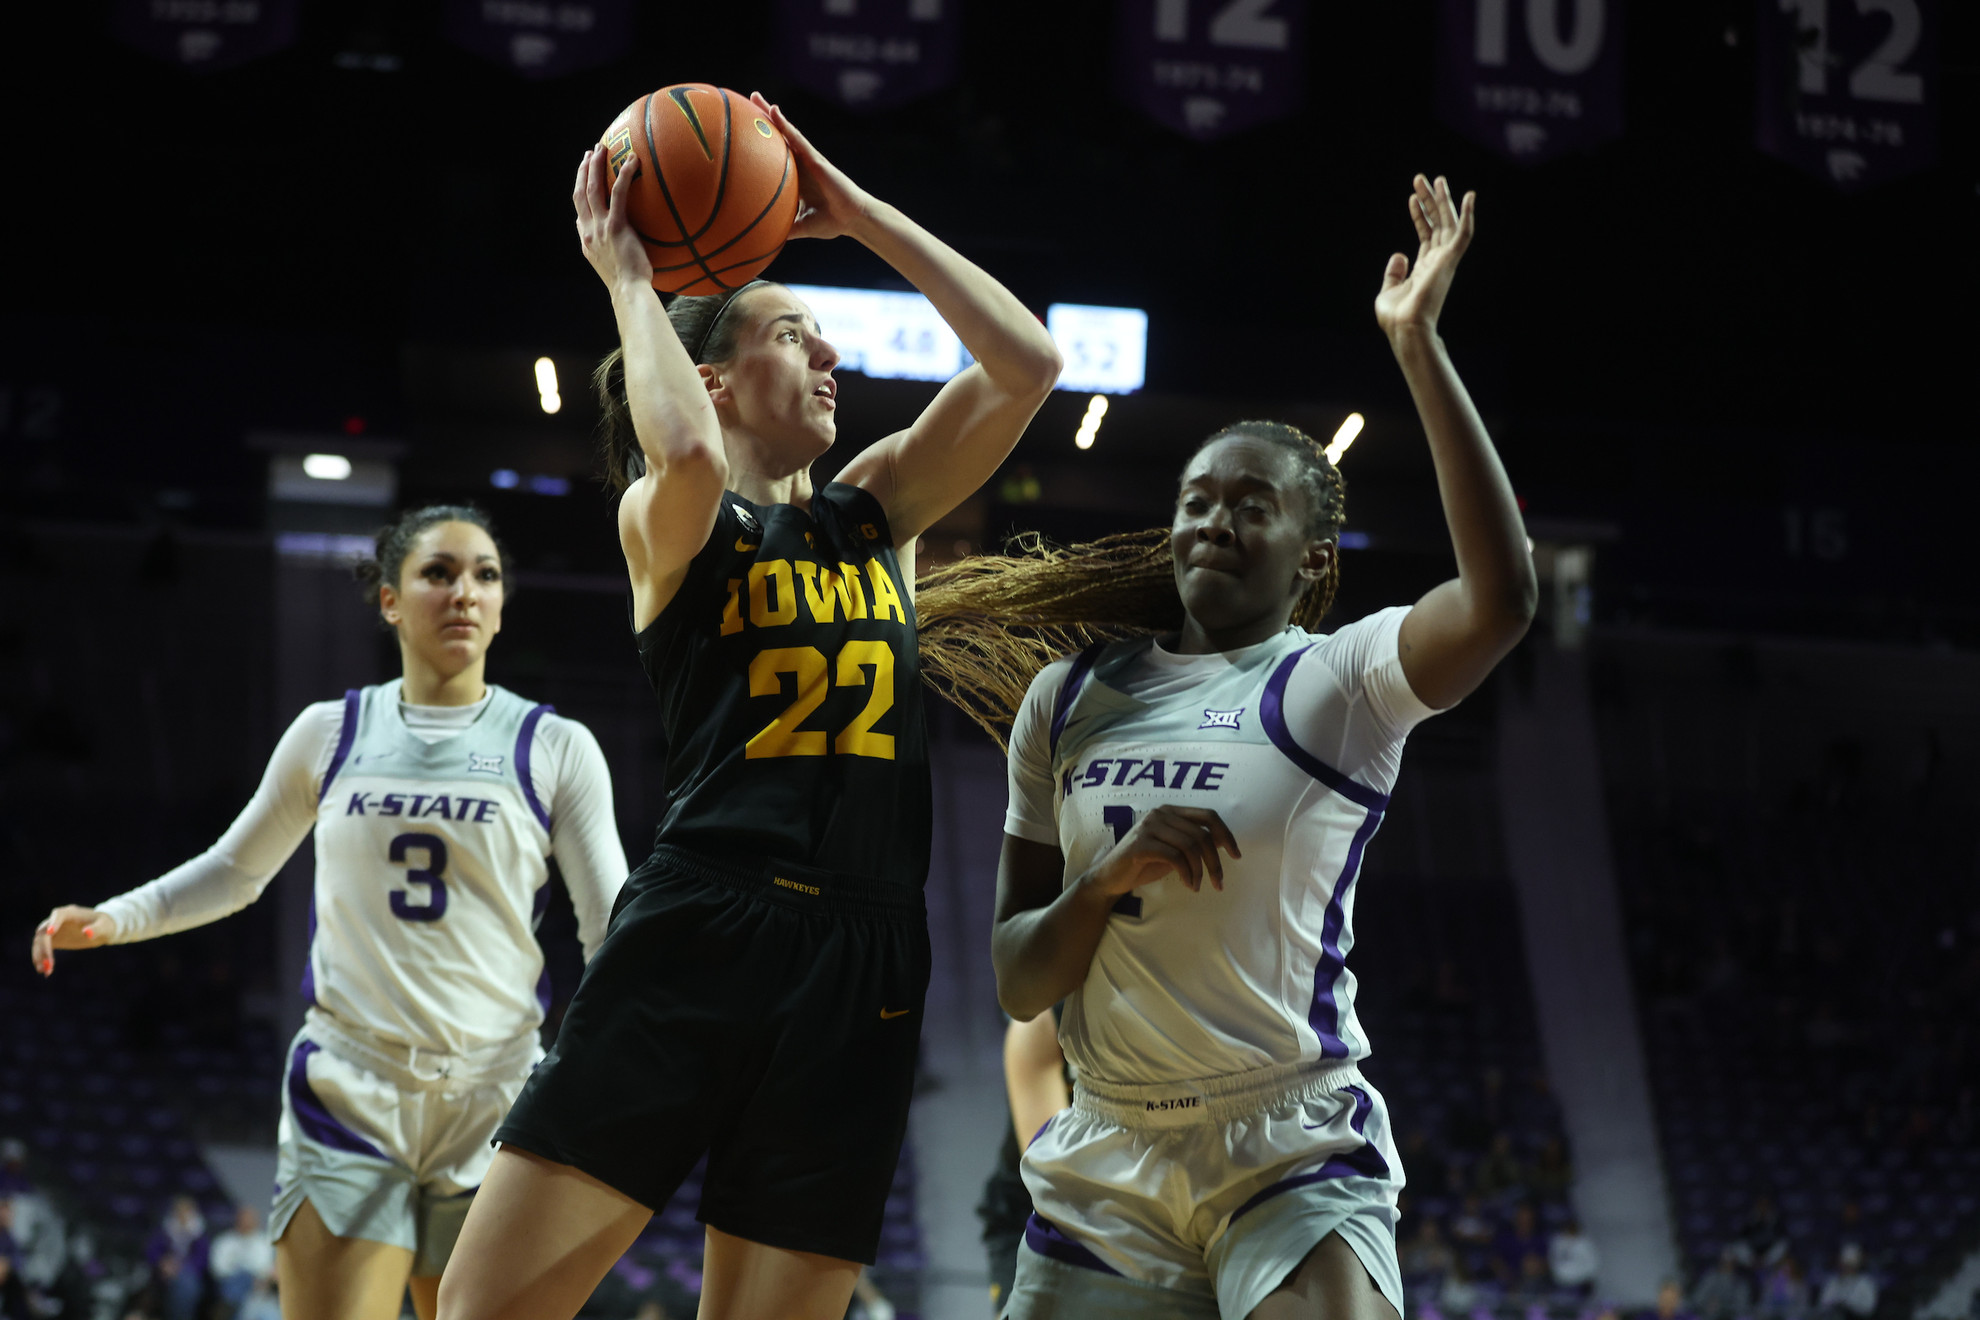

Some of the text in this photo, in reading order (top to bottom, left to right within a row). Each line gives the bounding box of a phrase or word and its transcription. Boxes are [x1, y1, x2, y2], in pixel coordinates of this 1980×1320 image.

[1474, 0, 1607, 76] 10
[1777, 0, 1925, 105] 12
[719, 557, 907, 637] IOWA
[745, 640, 896, 761] 22
[345, 792, 500, 823] K-STATE
[1062, 758, 1230, 800] K-STATE
[388, 832, 448, 922] 3
[773, 876, 820, 896] HAWKEYES
[1146, 1096, 1201, 1112] K-STATE
